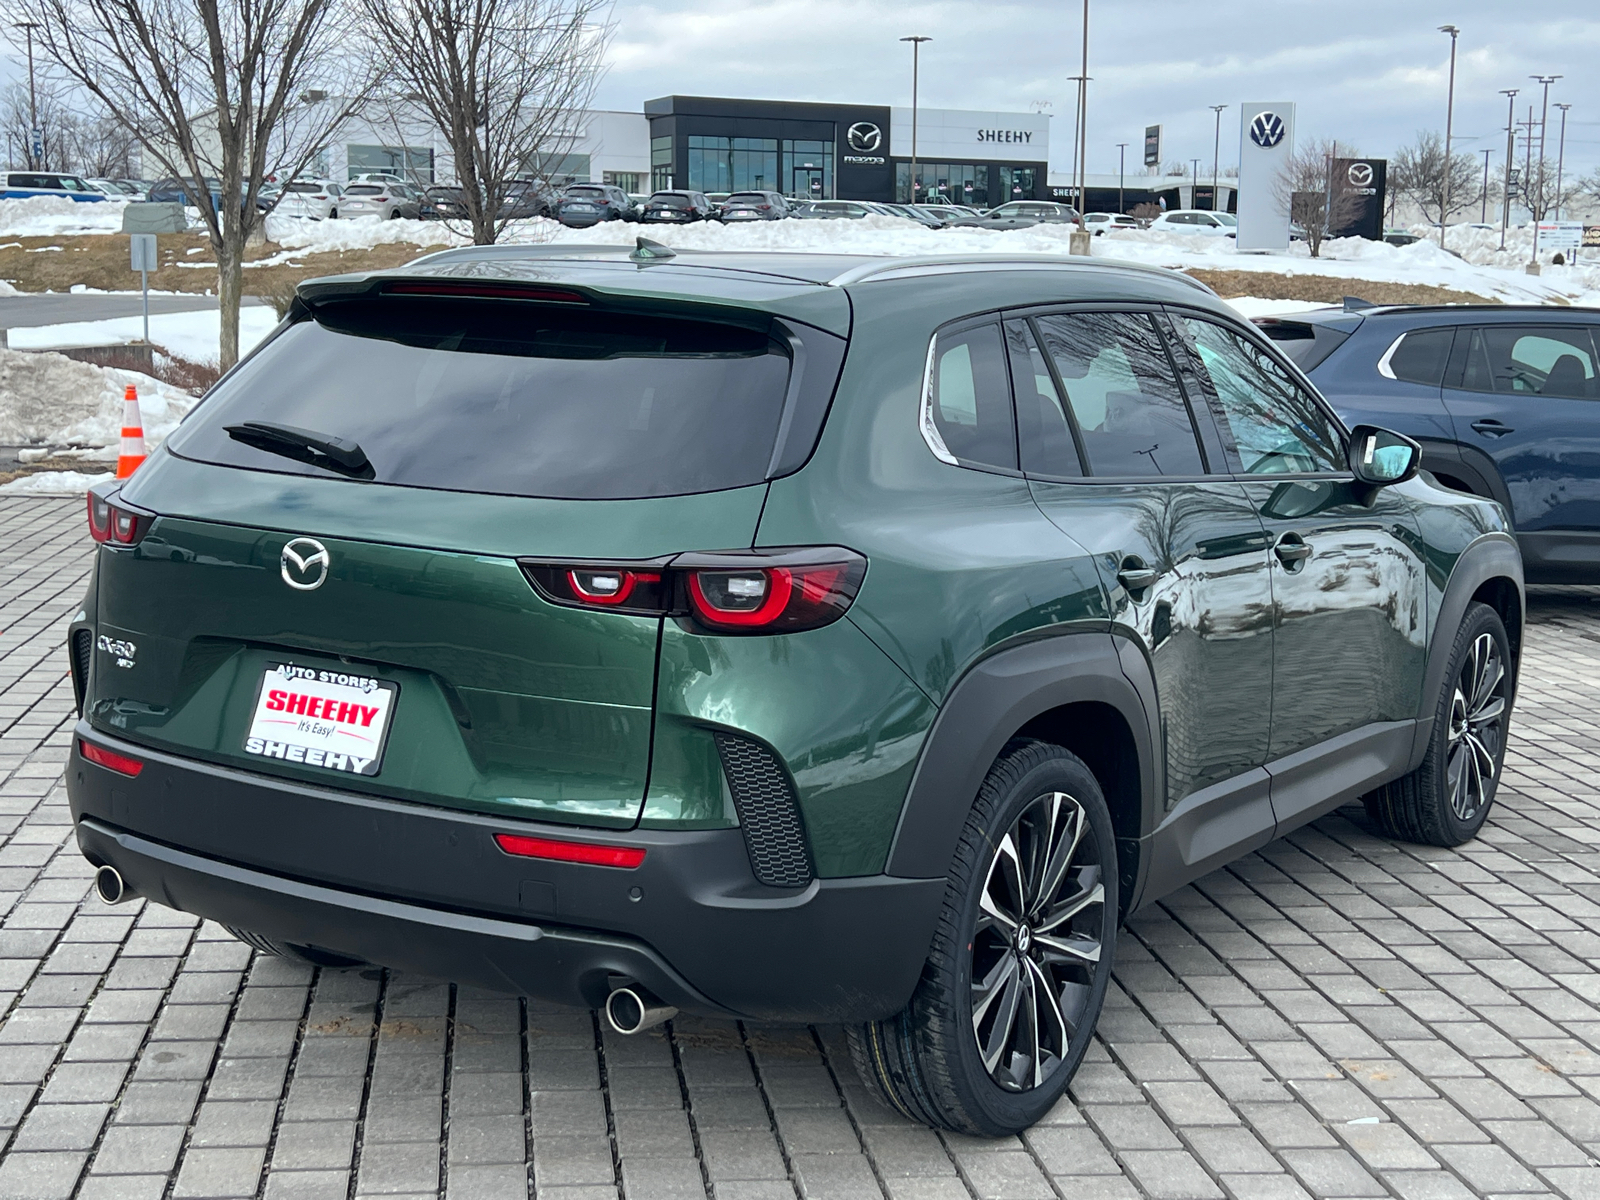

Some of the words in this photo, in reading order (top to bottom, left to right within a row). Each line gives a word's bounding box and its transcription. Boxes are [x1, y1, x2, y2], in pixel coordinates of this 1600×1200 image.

[977, 129, 1033, 143] SHEEHY
[843, 155, 885, 165] mazda
[276, 664, 316, 680] AUTO
[319, 671, 379, 691] STORES
[265, 689, 380, 728] SHEEHY
[297, 720, 311, 732] It's
[311, 722, 336, 738] Easy!
[245, 737, 373, 774] SHEEHY
